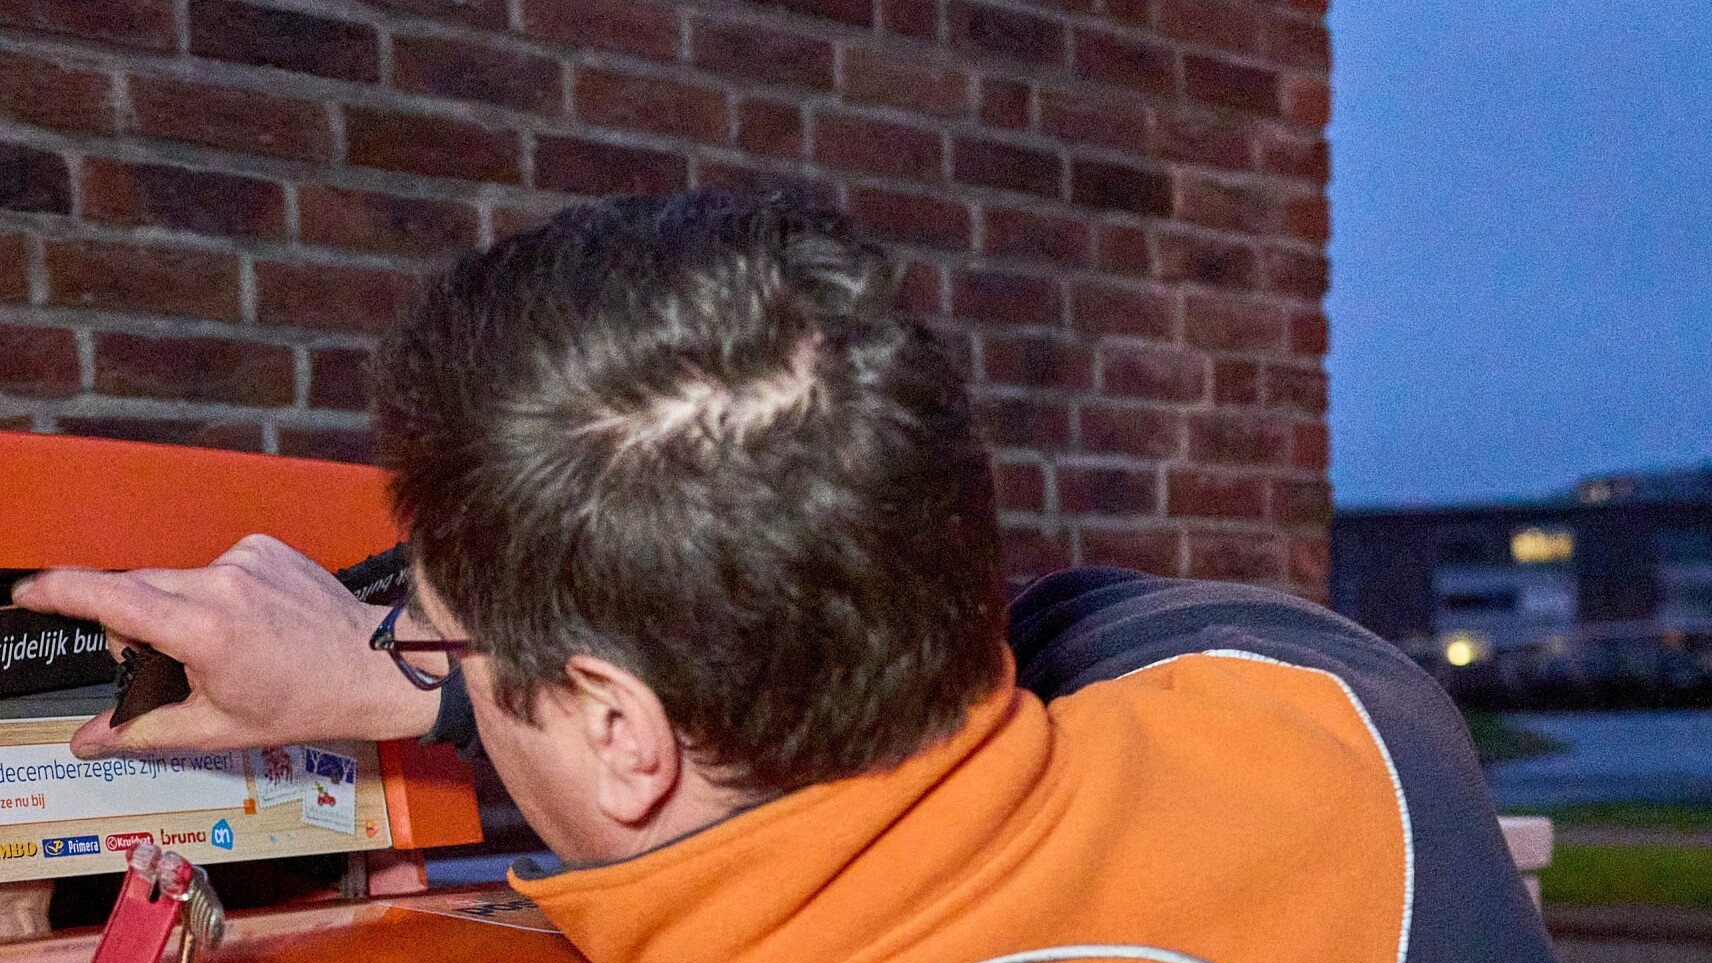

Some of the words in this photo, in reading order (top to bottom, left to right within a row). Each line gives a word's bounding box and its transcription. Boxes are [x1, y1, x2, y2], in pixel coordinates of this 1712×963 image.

[139, 755, 168, 779] zijn
[170, 756, 187, 773] er
[190, 752, 233, 772] weer!
[0, 799, 13, 809] ze
[15, 796, 29, 808] nu
[31, 793, 46, 810] bij
[68, 838, 100, 854] Primera
[160, 829, 206, 846] bruna
